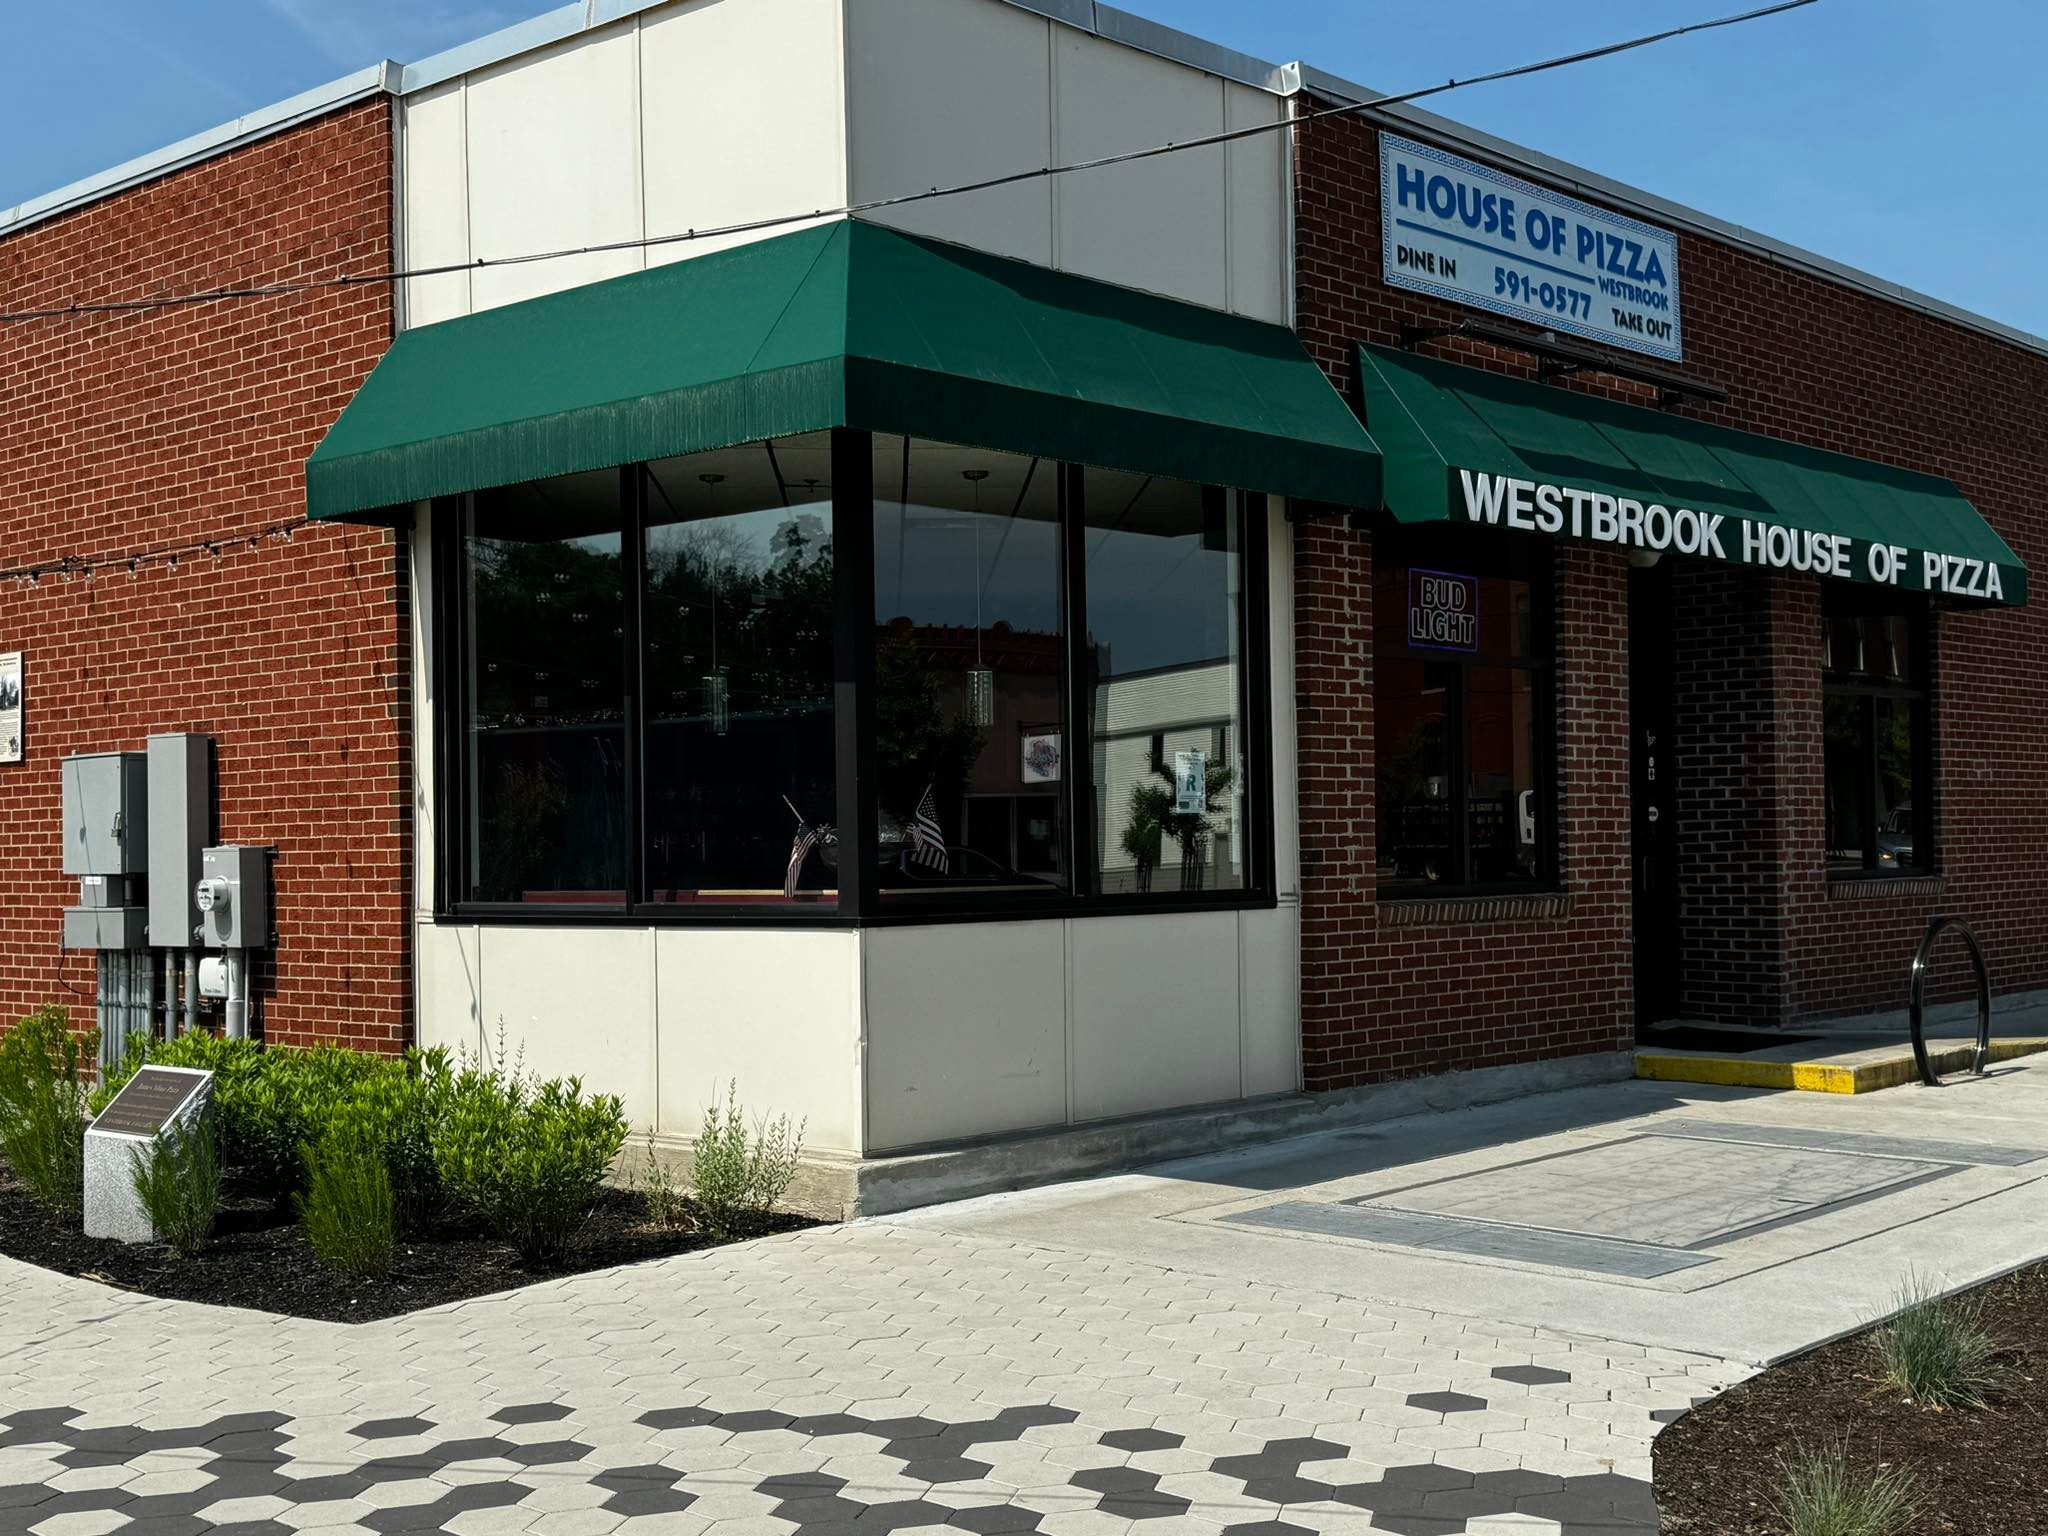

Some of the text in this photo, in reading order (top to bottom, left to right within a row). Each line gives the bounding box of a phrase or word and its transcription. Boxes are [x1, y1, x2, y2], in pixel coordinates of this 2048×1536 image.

[1396, 163, 1667, 289] HOUSE OF PIZZA
[1397, 244, 1457, 280] DINE IN
[1494, 266, 1592, 321] 591-0577
[1598, 275, 1669, 312] WESTBROOK
[1611, 308, 1672, 342] TAKE OUT
[1460, 469, 2004, 600] WESTBROOK HOUSE OF PIZZA
[1421, 576, 1466, 611] BUD
[1412, 607, 1475, 643] LIGHT
